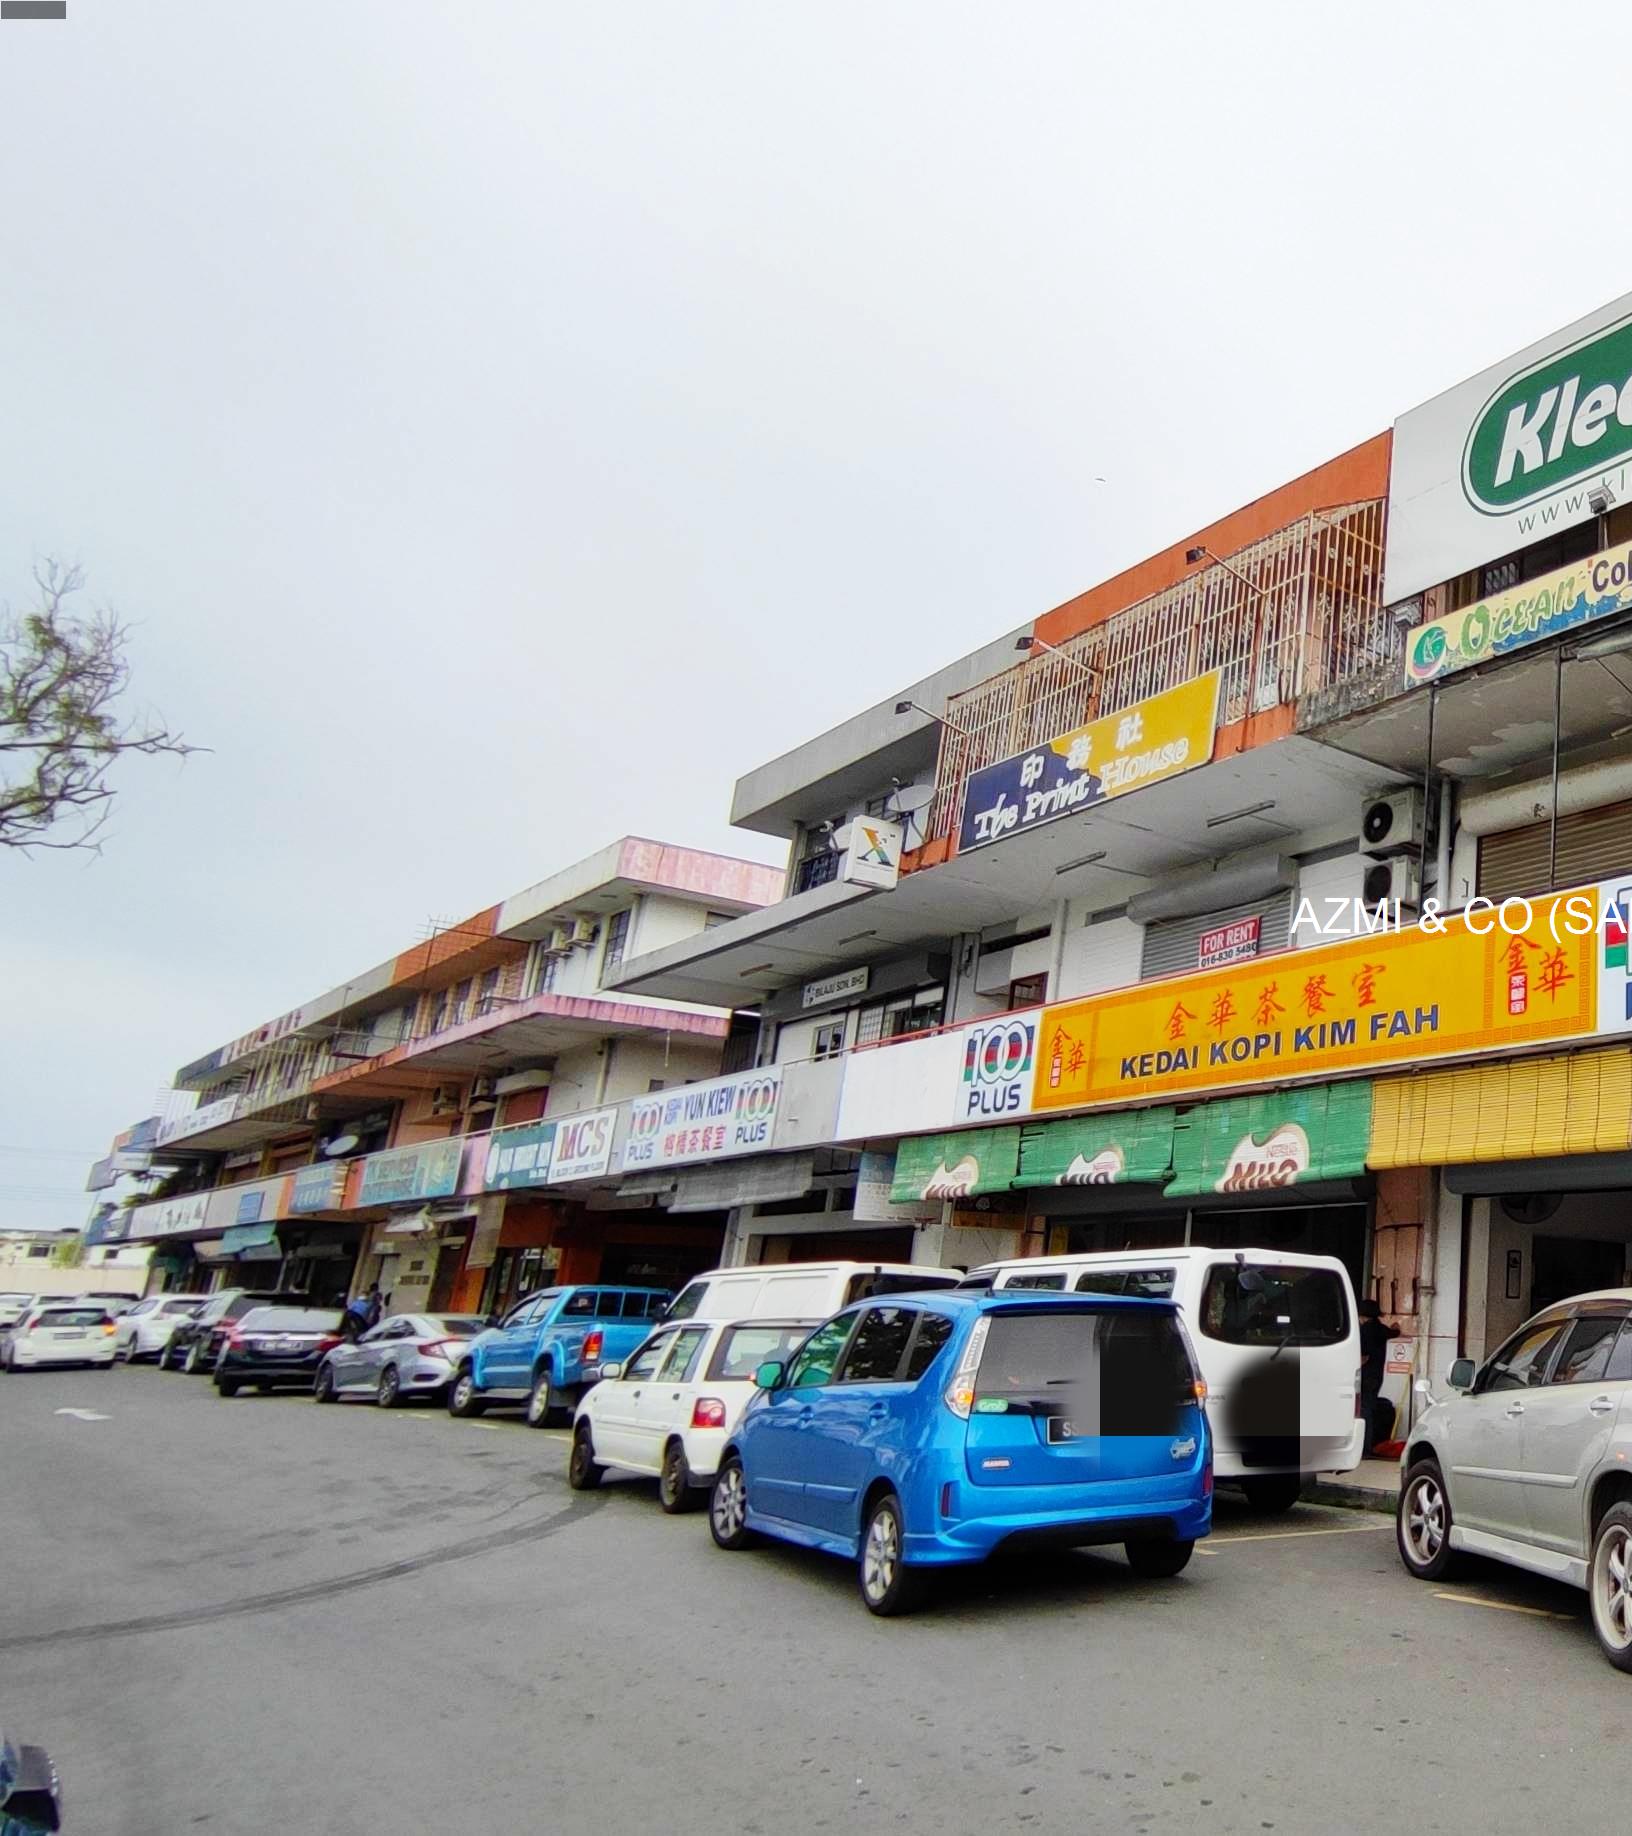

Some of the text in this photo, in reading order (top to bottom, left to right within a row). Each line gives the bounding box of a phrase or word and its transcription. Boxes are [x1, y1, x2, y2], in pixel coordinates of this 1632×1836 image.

[974, 738, 1189, 839] The Print House
[1203, 921, 1256, 954] FOR RENT
[970, 1020, 1029, 1087] 100
[1120, 1005, 1439, 1080] KEDAI KOPI KIM FAH
[967, 1083, 1022, 1117] PLUS
[557, 1117, 610, 1162] MCS
[735, 1122, 767, 1144] PLUS
[626, 1142, 654, 1161] PLUS
[1223, 1158, 1298, 1193] MILO
